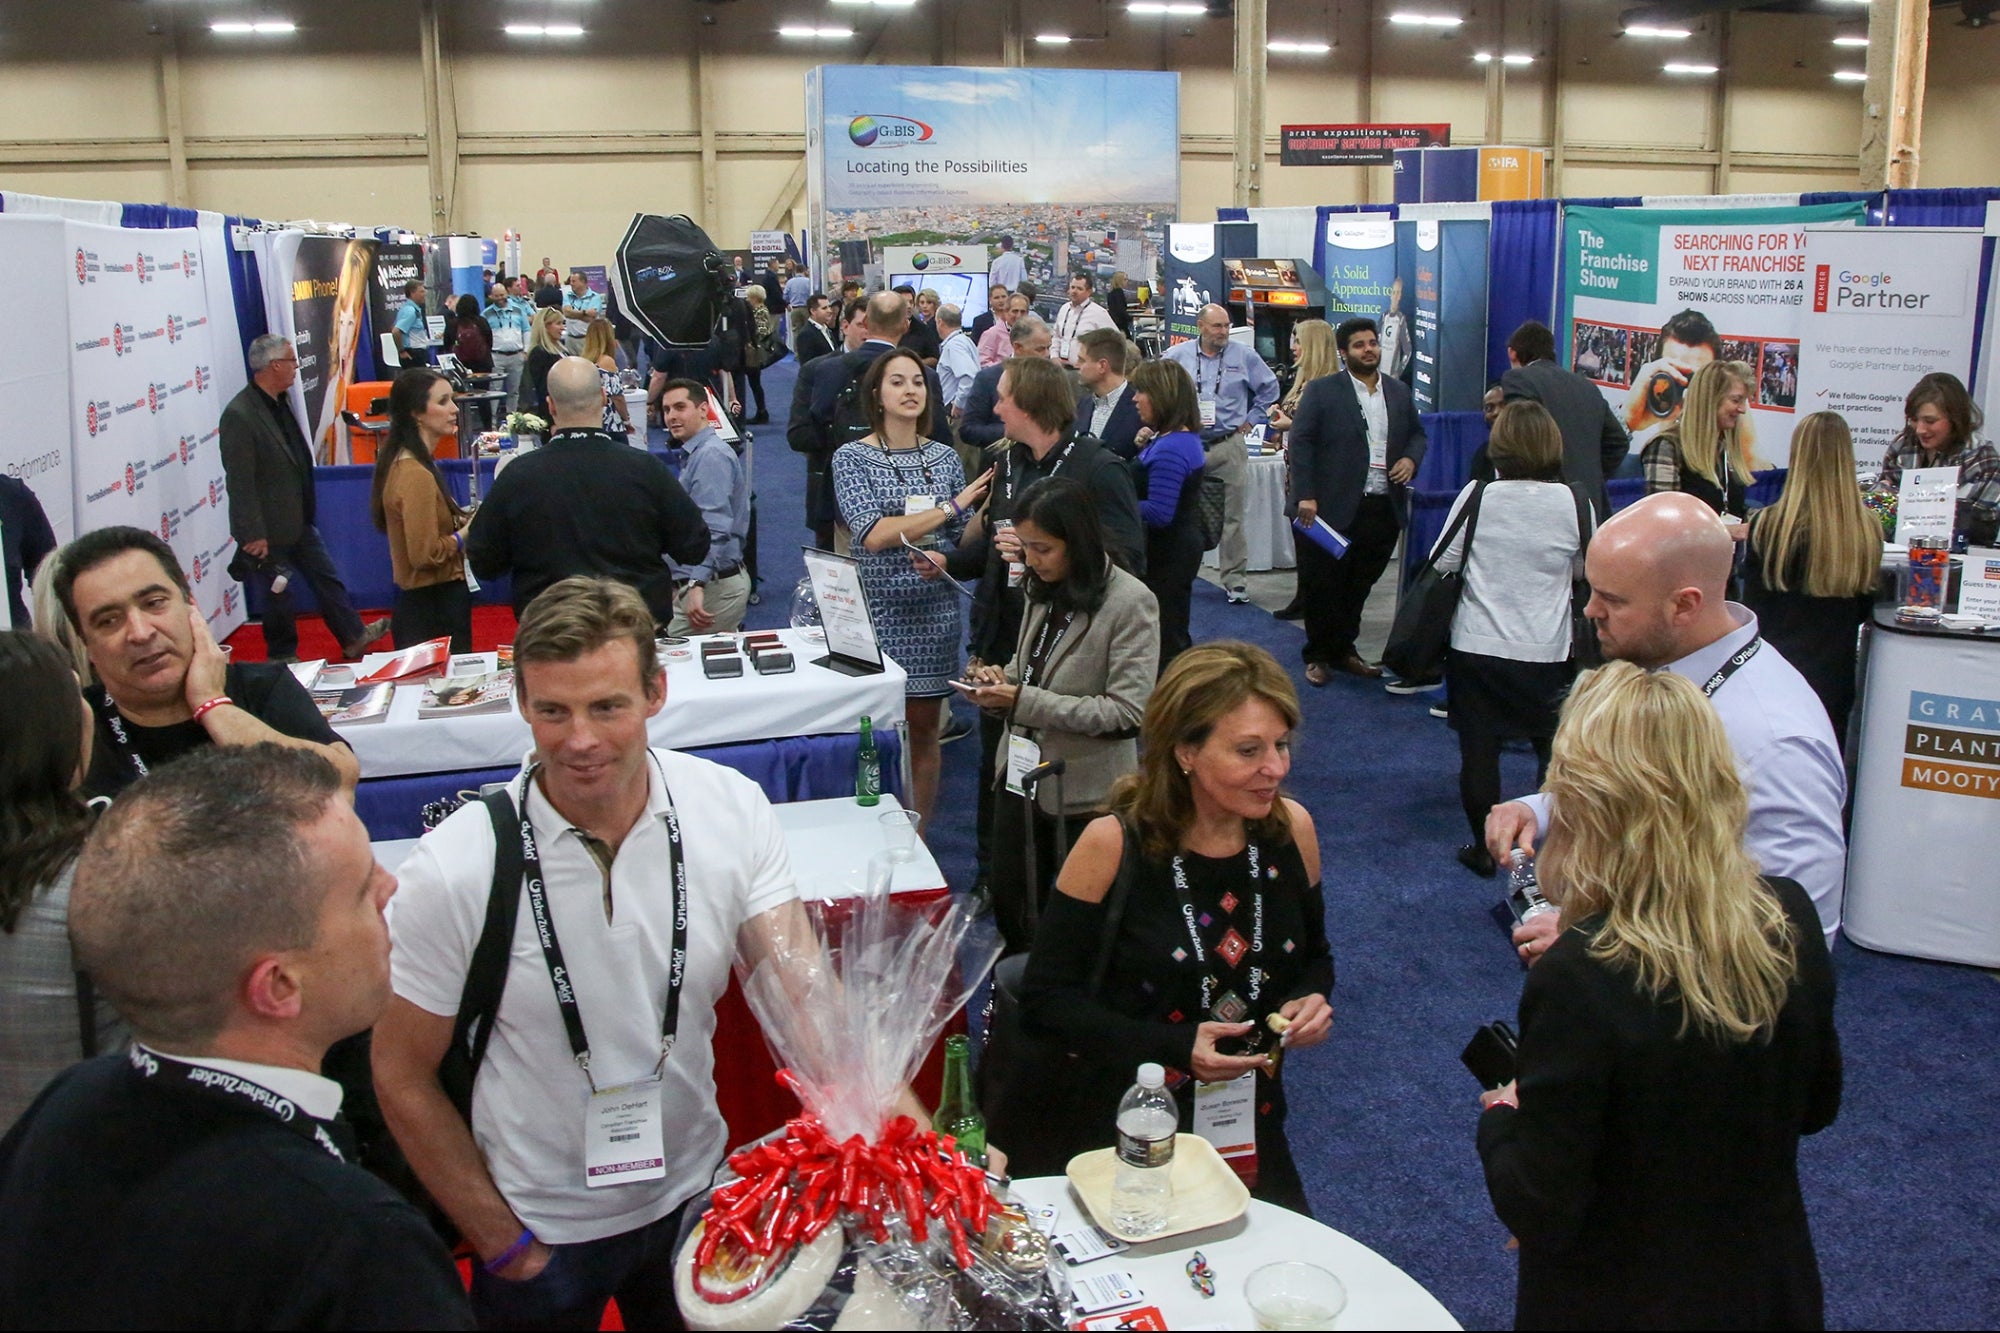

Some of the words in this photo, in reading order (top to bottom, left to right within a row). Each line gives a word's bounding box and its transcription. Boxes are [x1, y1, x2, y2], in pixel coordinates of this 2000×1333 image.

[1324, 129, 1392, 138] expositions,
[1400, 128, 1420, 136] inc.
[1288, 137, 1338, 150] customer
[1341, 137, 1381, 150] service
[1383, 136, 1420, 149] center
[847, 160, 909, 176] Locating
[915, 160, 939, 173] the
[945, 160, 1028, 173] Possibilities
[1394, 160, 1403, 170] FA
[1502, 157, 1519, 168] IFA
[1578, 230, 1604, 249] The
[1674, 233, 1753, 251] SEARCHING
[1758, 234, 1788, 250] FOR
[1580, 249, 1648, 273] Franchise
[1683, 255, 1719, 271] NEXT
[1723, 255, 1805, 272] FRANCHISE
[388, 263, 419, 278] NetSearch
[1331, 266, 1341, 279] A
[1344, 265, 1369, 280] Solid
[1580, 268, 1619, 289] Show
[1839, 270, 1892, 287] Google
[313, 277, 338, 297] Phone!
[1331, 281, 1380, 299] Approach
[1382, 283, 1392, 297] to
[1669, 276, 1700, 288] EXPAND
[1702, 278, 1726, 289] YOUR
[1727, 279, 1757, 290] BRAND
[1759, 279, 1781, 290] WITH
[1784, 279, 1795, 290] 26
[1817, 270, 1827, 306] PREMIER
[1331, 298, 1381, 314] Insurance
[1677, 291, 1708, 302] SHOWS
[1709, 292, 1745, 304] ACROSS
[1747, 294, 1778, 305] NORTH
[1837, 286, 1930, 308] Partner
[1815, 344, 1831, 353] We
[1833, 345, 1857, 354] have
[1858, 346, 1892, 355] earned
[1894, 347, 1909, 356] the
[1912, 347, 1951, 357] Premier
[1830, 360, 1863, 371] Google
[1866, 360, 1901, 370] Partner
[1903, 362, 1934, 373] badge
[1843, 392, 1867, 400] follow
[1868, 393, 1903, 403] Google's
[1827, 403, 1845, 411] best
[1846, 404, 1883, 412] practices
[1859, 438, 1891, 446] individu
[1963, 580, 1984, 588] Guess
[1704, 671, 1726, 697] unkin'
[1912, 766, 2000, 792] MOOTY
[521, 820, 537, 860] dunkin'
[1248, 844, 1259, 878] dunkin'
[1172, 855, 1189, 889] dunkin'
[676, 862, 686, 917] FisherZucker
[531, 893, 551, 949] FisherZucker
[1253, 893, 1262, 940] FisherZucker
[1185, 916, 1205, 962] FisherZucker
[671, 948, 684, 987] dunkin'
[553, 966, 574, 1003] dunkin'
[1249, 966, 1262, 1000] dunkin'
[188, 1067, 278, 1109] FisherZucker
[601, 1106, 620, 1114] John
[621, 1101, 648, 1111] DeHart
[595, 1159, 656, 1175] NON-MEMBER
